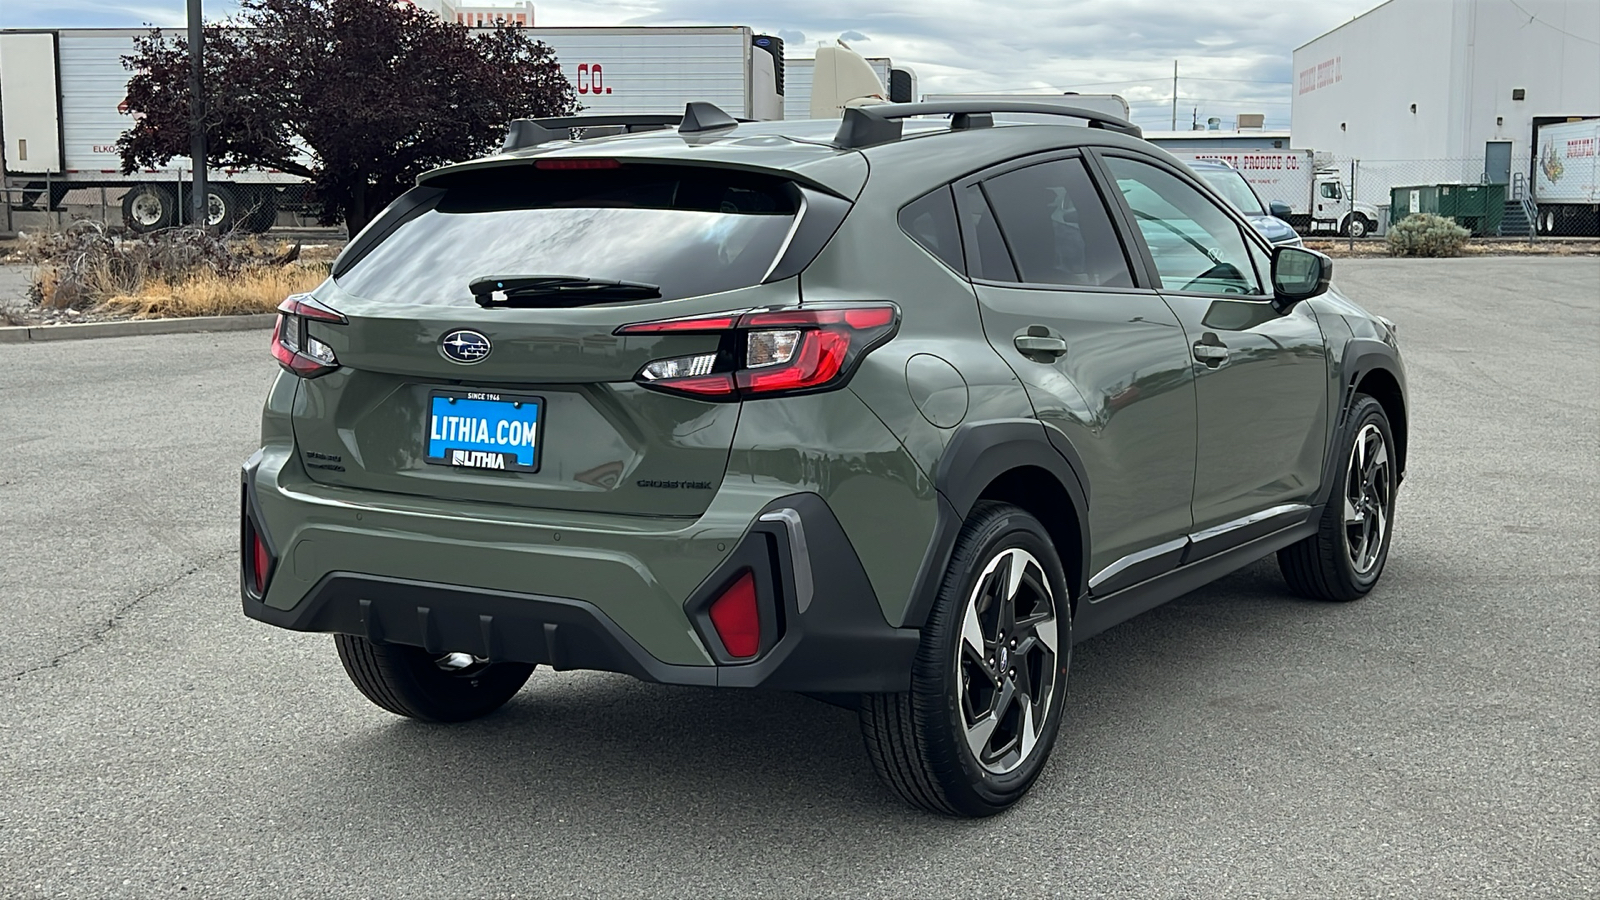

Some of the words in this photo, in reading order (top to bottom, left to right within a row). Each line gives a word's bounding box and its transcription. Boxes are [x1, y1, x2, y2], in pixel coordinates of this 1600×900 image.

[577, 63, 612, 95] CO.
[1244, 155, 1282, 169] PRODUCE
[1286, 155, 1299, 169] CO.
[467, 392, 485, 400] SINCE
[430, 415, 537, 447] LITHIA.COM
[463, 451, 505, 469] LITHIA
[636, 480, 712, 490] CROSSTREK
